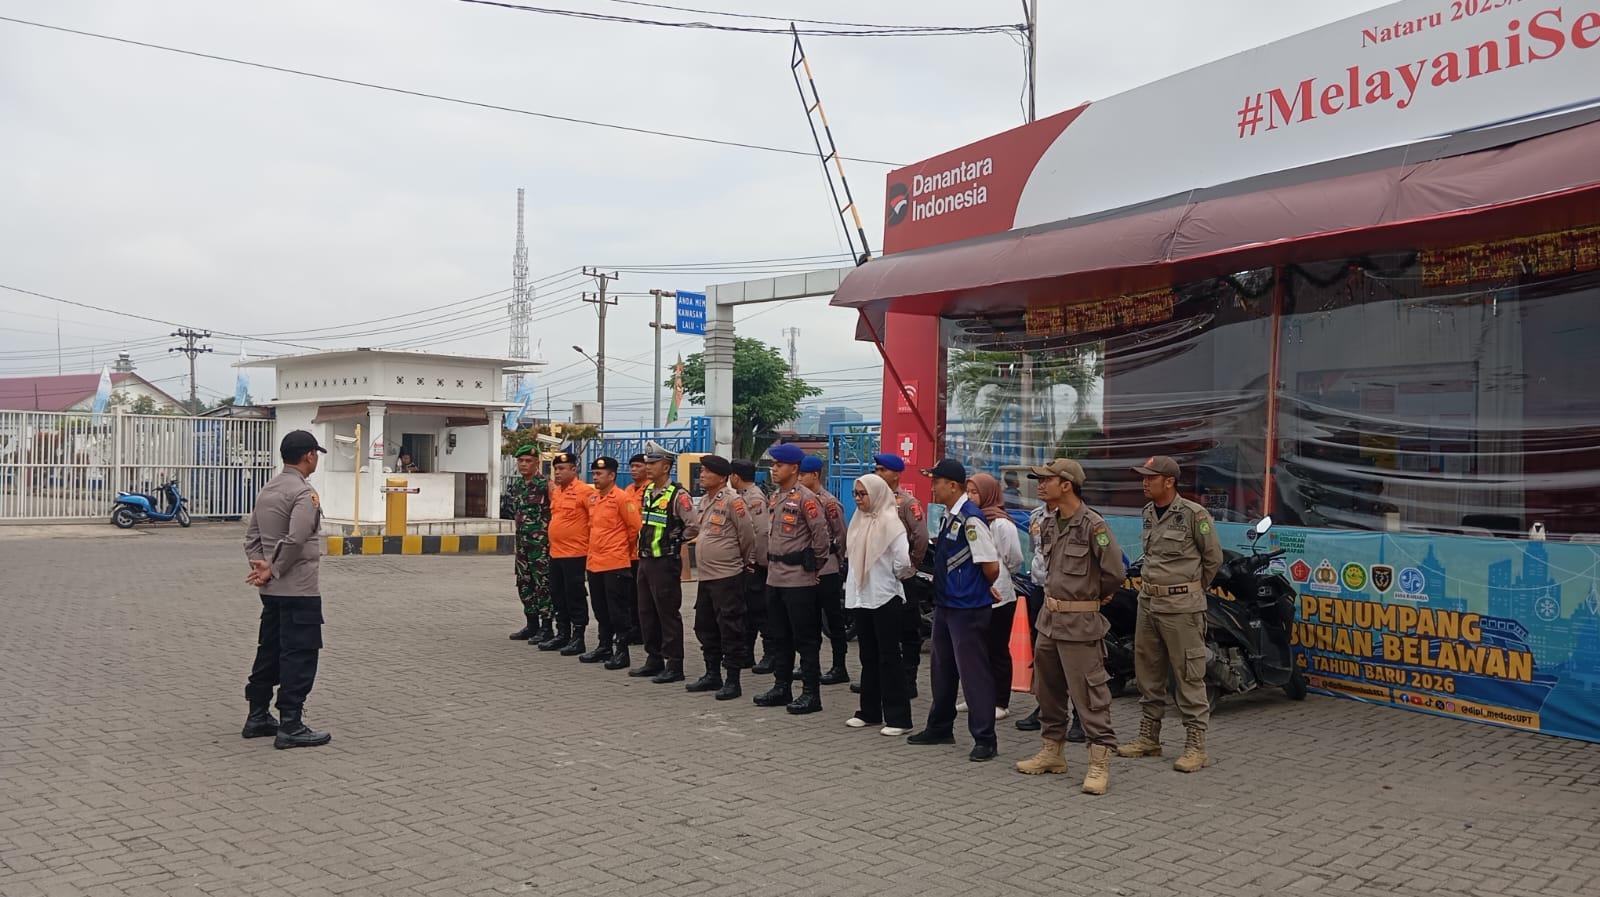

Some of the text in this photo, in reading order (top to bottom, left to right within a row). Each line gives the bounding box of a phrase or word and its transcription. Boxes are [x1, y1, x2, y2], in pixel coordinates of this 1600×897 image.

[1361, 11, 1442, 48] Nataru
[1237, 6, 1600, 138] #MelayaniSe
[912, 157, 993, 197] Danantara
[912, 183, 987, 221] Indonesia
[1300, 595, 1481, 643] PENUMPANG
[1296, 653, 1455, 692] & TAHUN BARU 2026
[1382, 634, 1533, 681] BELAWAN
